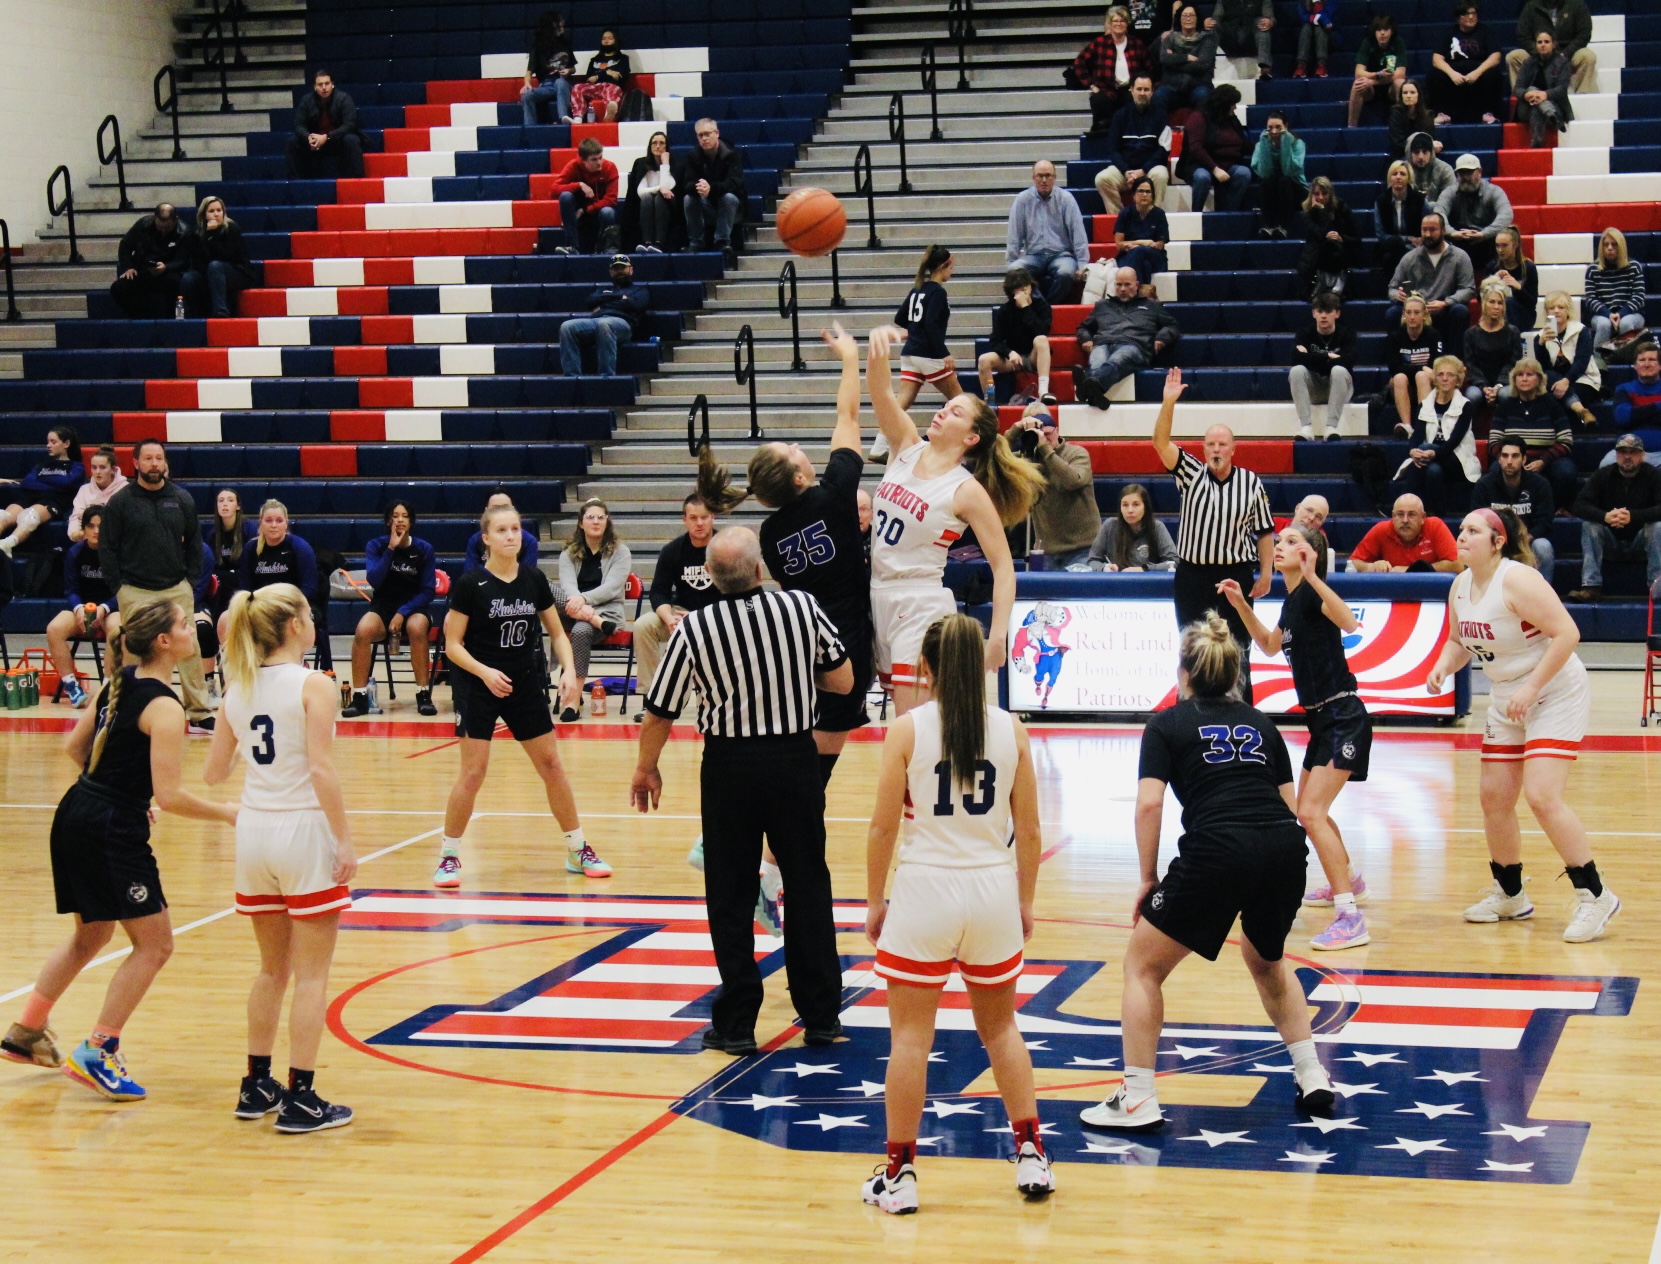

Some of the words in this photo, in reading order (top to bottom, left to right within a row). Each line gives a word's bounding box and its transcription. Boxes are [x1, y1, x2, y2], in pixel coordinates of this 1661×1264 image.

[907, 292, 927, 323] 15
[876, 480, 931, 523] PATRIOTS
[875, 509, 905, 547] 30
[776, 519, 836, 576] 35
[390, 560, 418, 574] uskies
[488, 598, 537, 619] Huskies
[1075, 605, 1145, 620] Welcome
[1153, 610, 1167, 620] to
[500, 620, 529, 648] 10
[1076, 631, 1113, 650] Red
[1123, 631, 1172, 650] Land
[1076, 662, 1120, 676] Home
[1129, 662, 1142, 676] of
[1149, 662, 1169, 676] the
[1076, 687, 1152, 706] Patriots
[250, 714, 276, 765] 3
[1198, 724, 1267, 765] 32
[933, 759, 997, 816] 13
